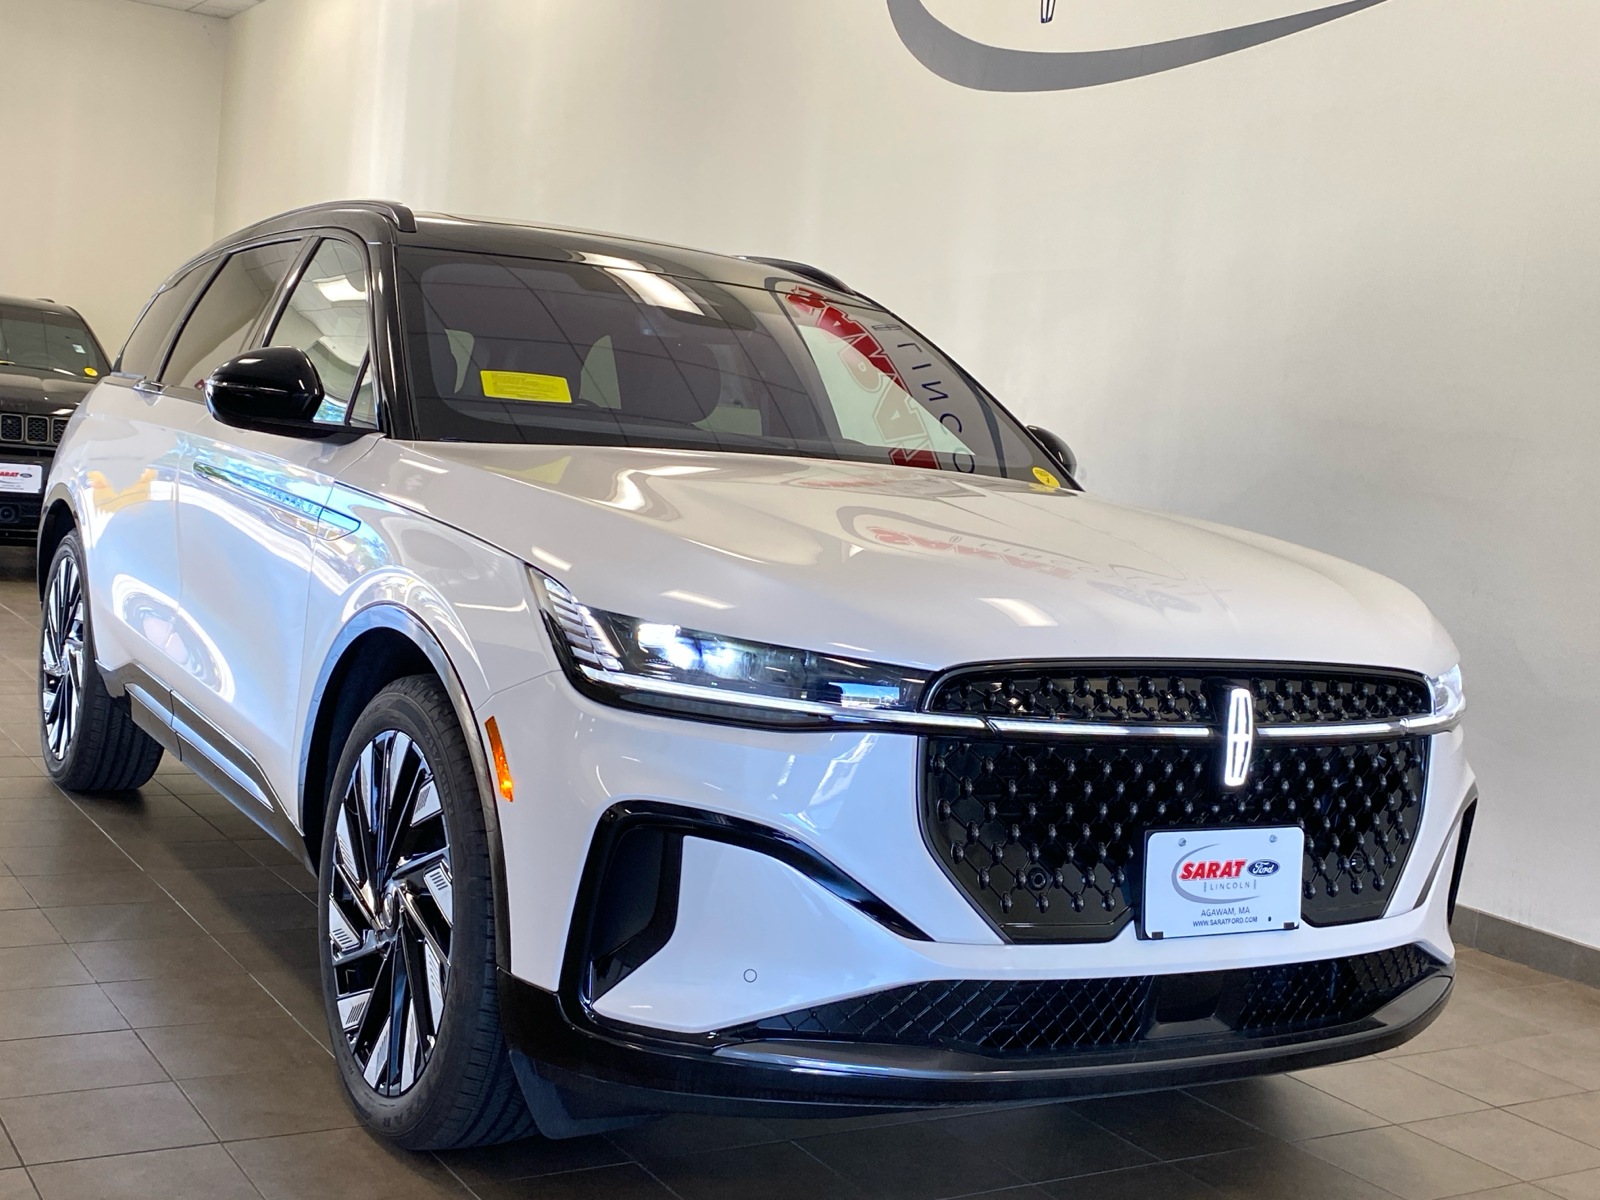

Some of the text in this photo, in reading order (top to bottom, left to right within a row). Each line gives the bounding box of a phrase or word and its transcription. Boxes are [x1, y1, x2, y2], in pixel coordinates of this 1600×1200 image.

[1180, 859, 1277, 880] SARAT Ford
[1210, 881, 1250, 891] LINCOLN
[1201, 906, 1251, 917] AGAWAM, MA
[1193, 916, 1258, 927] WWW.SARATFORD.COM
